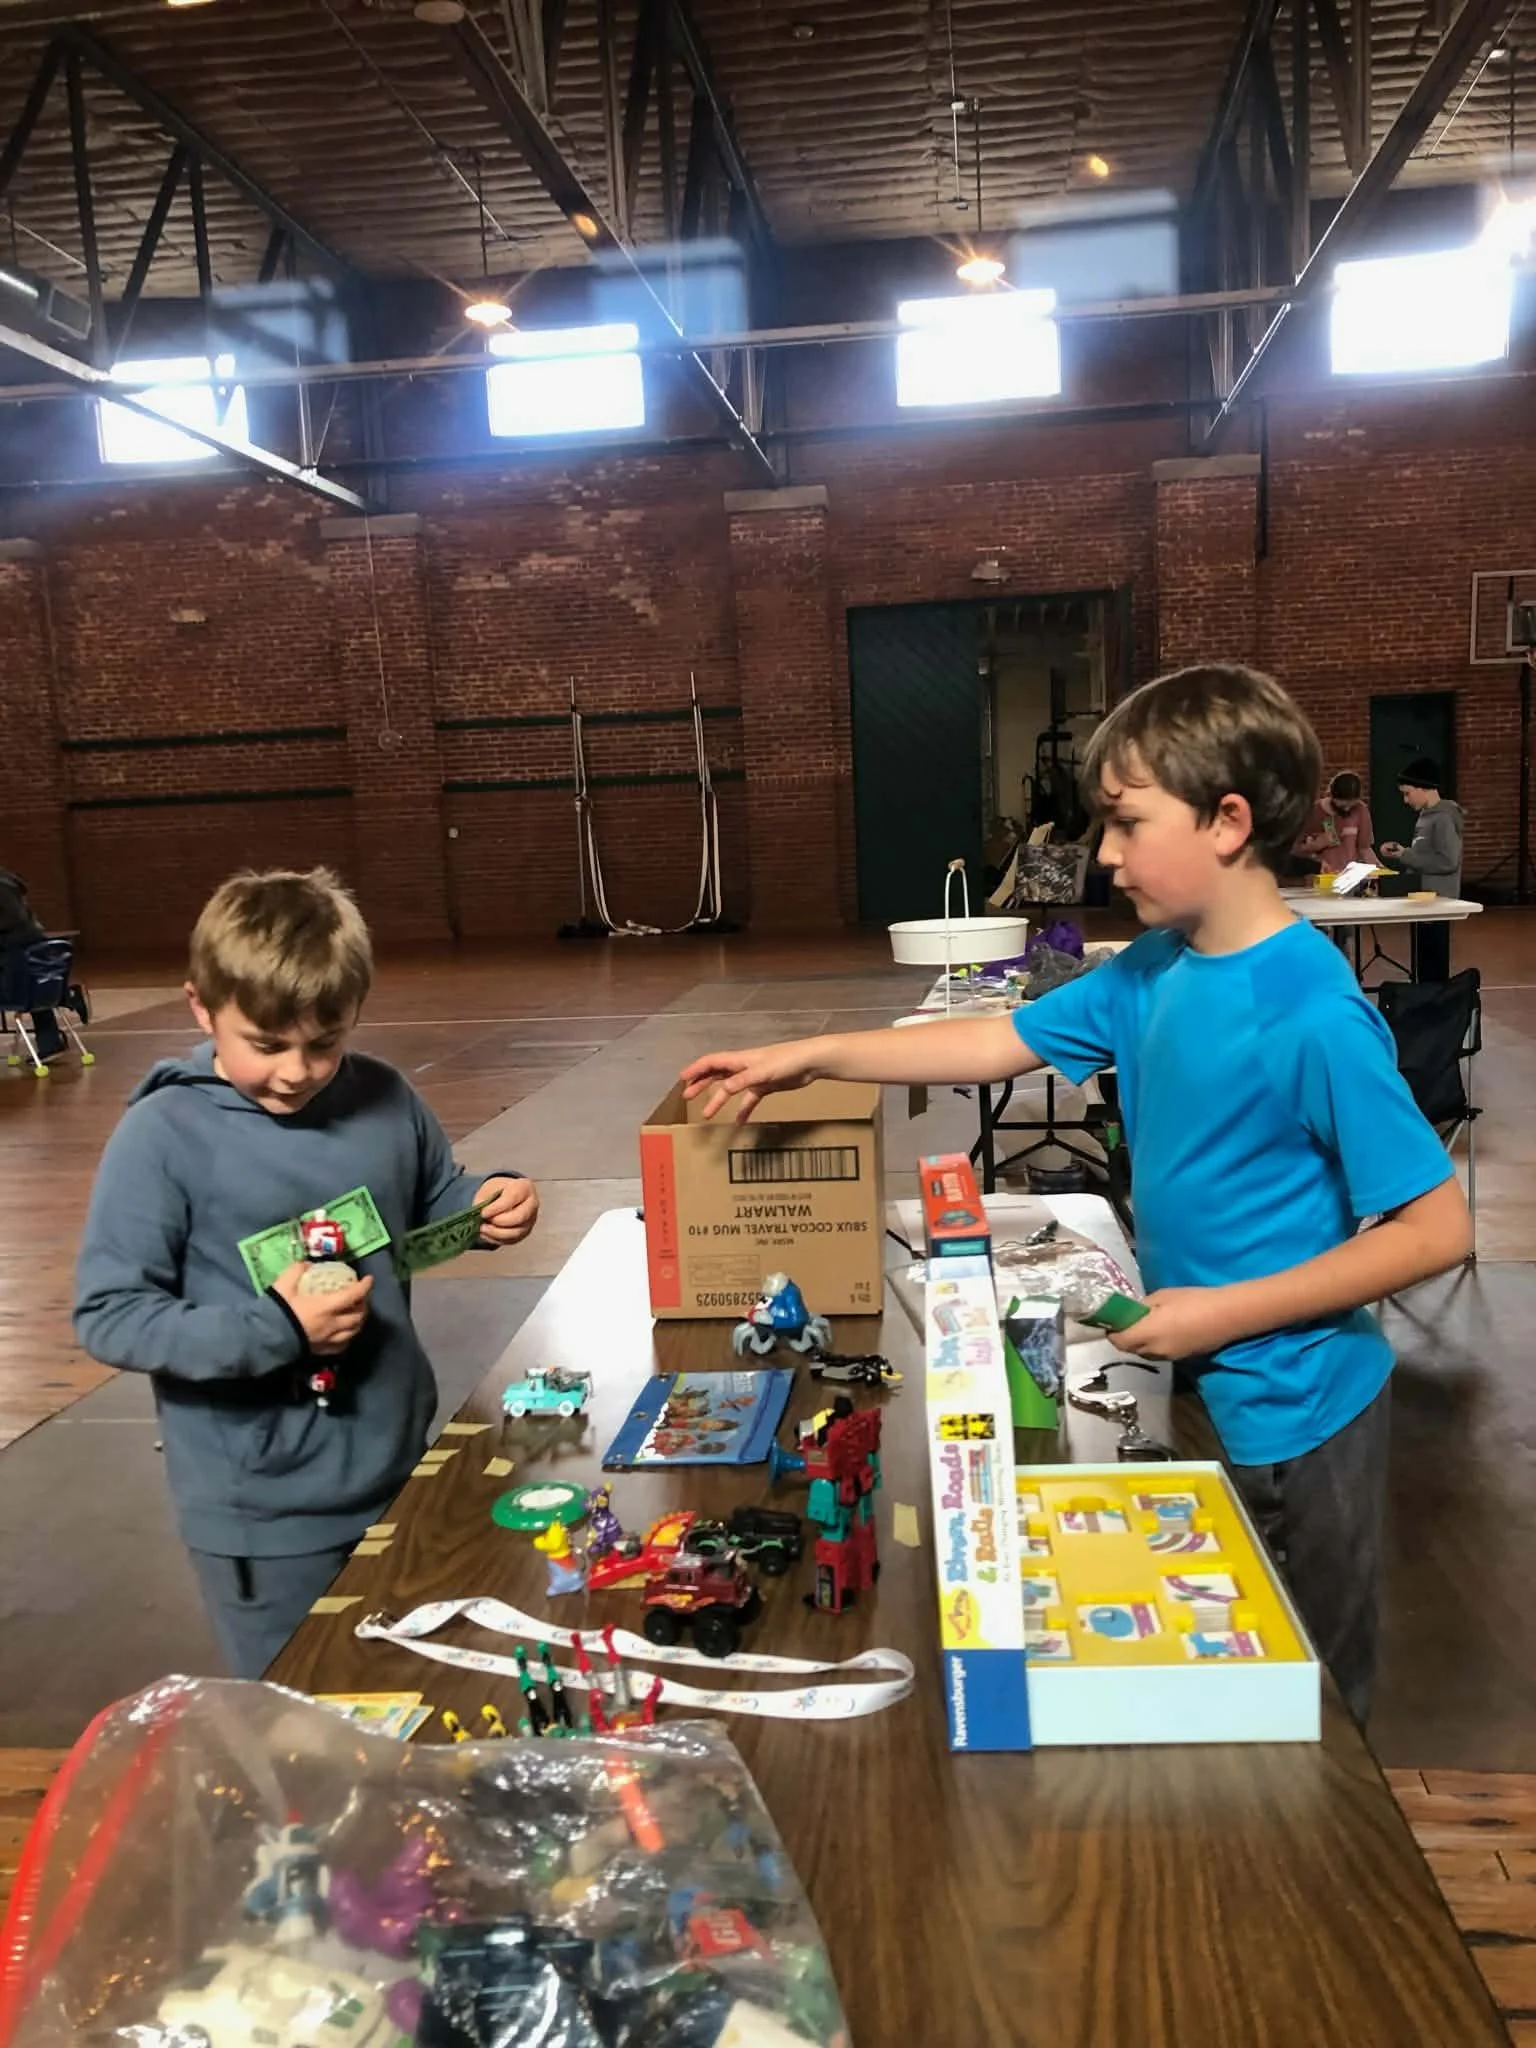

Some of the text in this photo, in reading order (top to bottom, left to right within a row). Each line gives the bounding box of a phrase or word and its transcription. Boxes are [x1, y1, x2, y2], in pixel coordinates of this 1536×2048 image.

[734, 1204, 812, 1218] WALMART
[688, 1221, 868, 1236] SBUX COCOA TRAVEL MUG #10
[950, 1655, 969, 1747] Ravensburger
